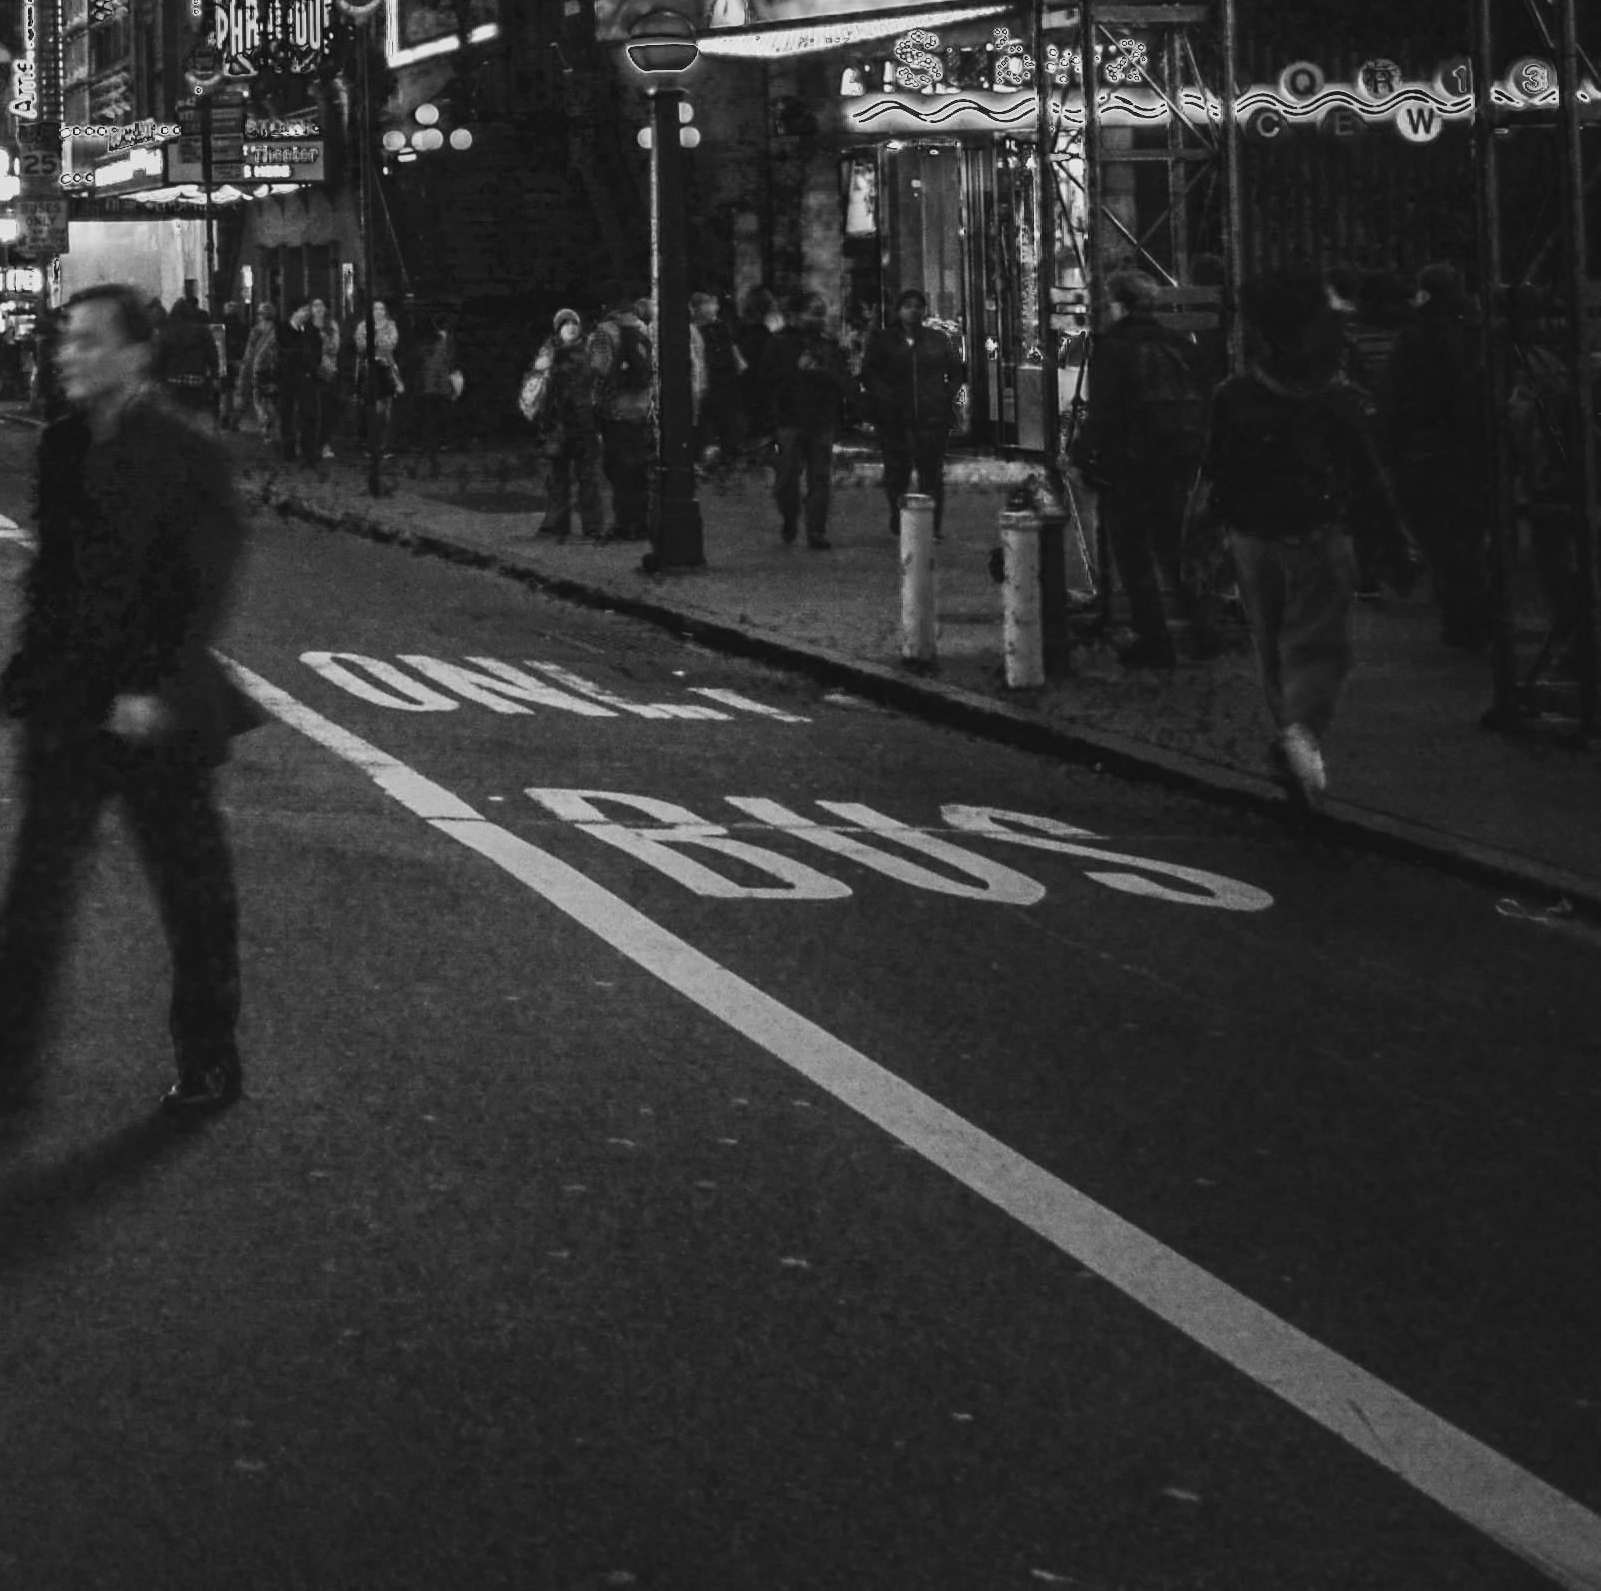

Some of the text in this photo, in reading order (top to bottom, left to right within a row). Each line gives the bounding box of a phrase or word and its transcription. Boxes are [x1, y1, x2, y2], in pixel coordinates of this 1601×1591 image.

[1521, 63, 1551, 94] 3
[1407, 107, 1435, 136] W
[22, 153, 57, 176] 25
[524, 787, 1275, 912] BUS
